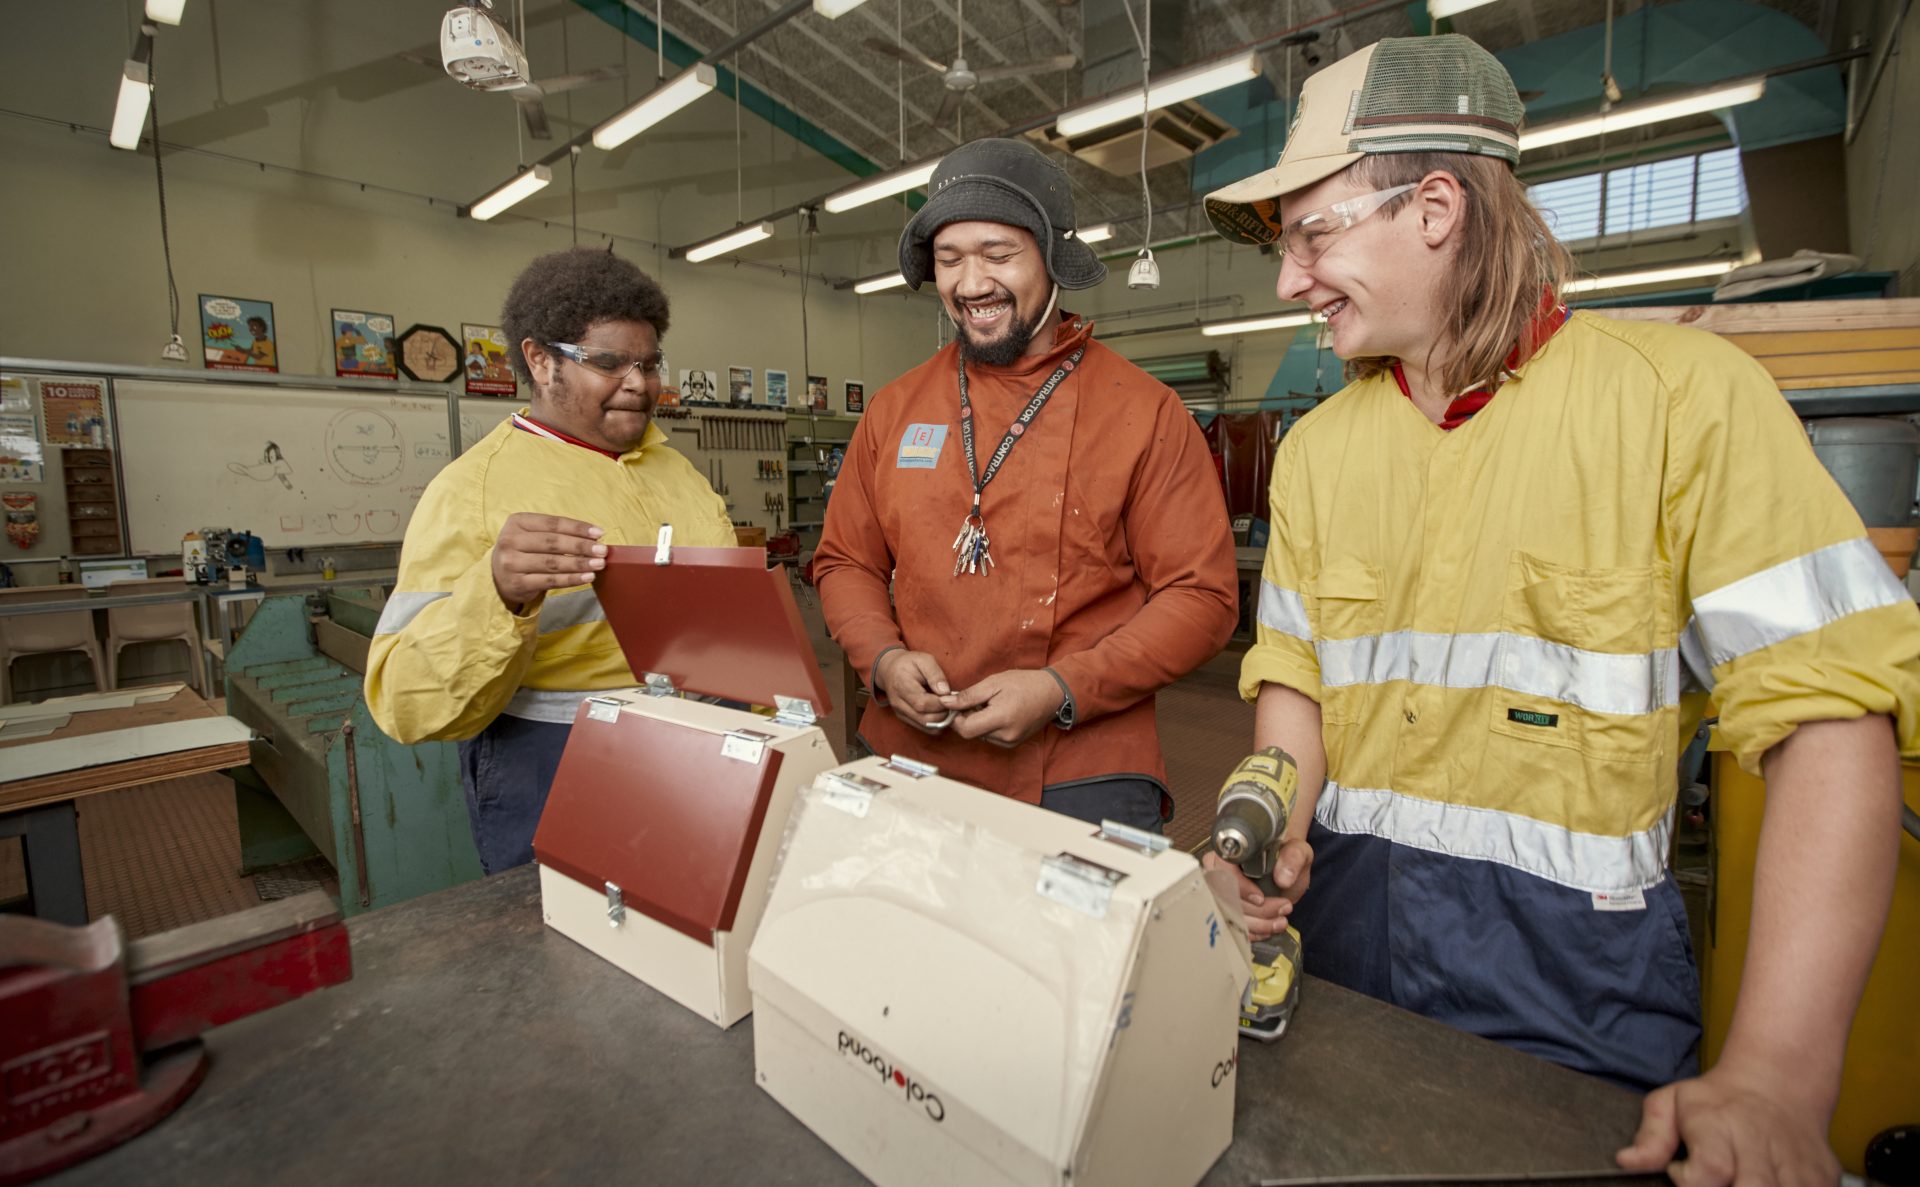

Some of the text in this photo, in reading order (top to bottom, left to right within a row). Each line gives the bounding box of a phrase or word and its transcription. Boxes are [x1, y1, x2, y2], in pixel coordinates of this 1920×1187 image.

[46, 386, 67, 398] 10
[1019, 369, 1065, 423] CONTRACTOR
[838, 1030, 945, 1122] Colorbond
